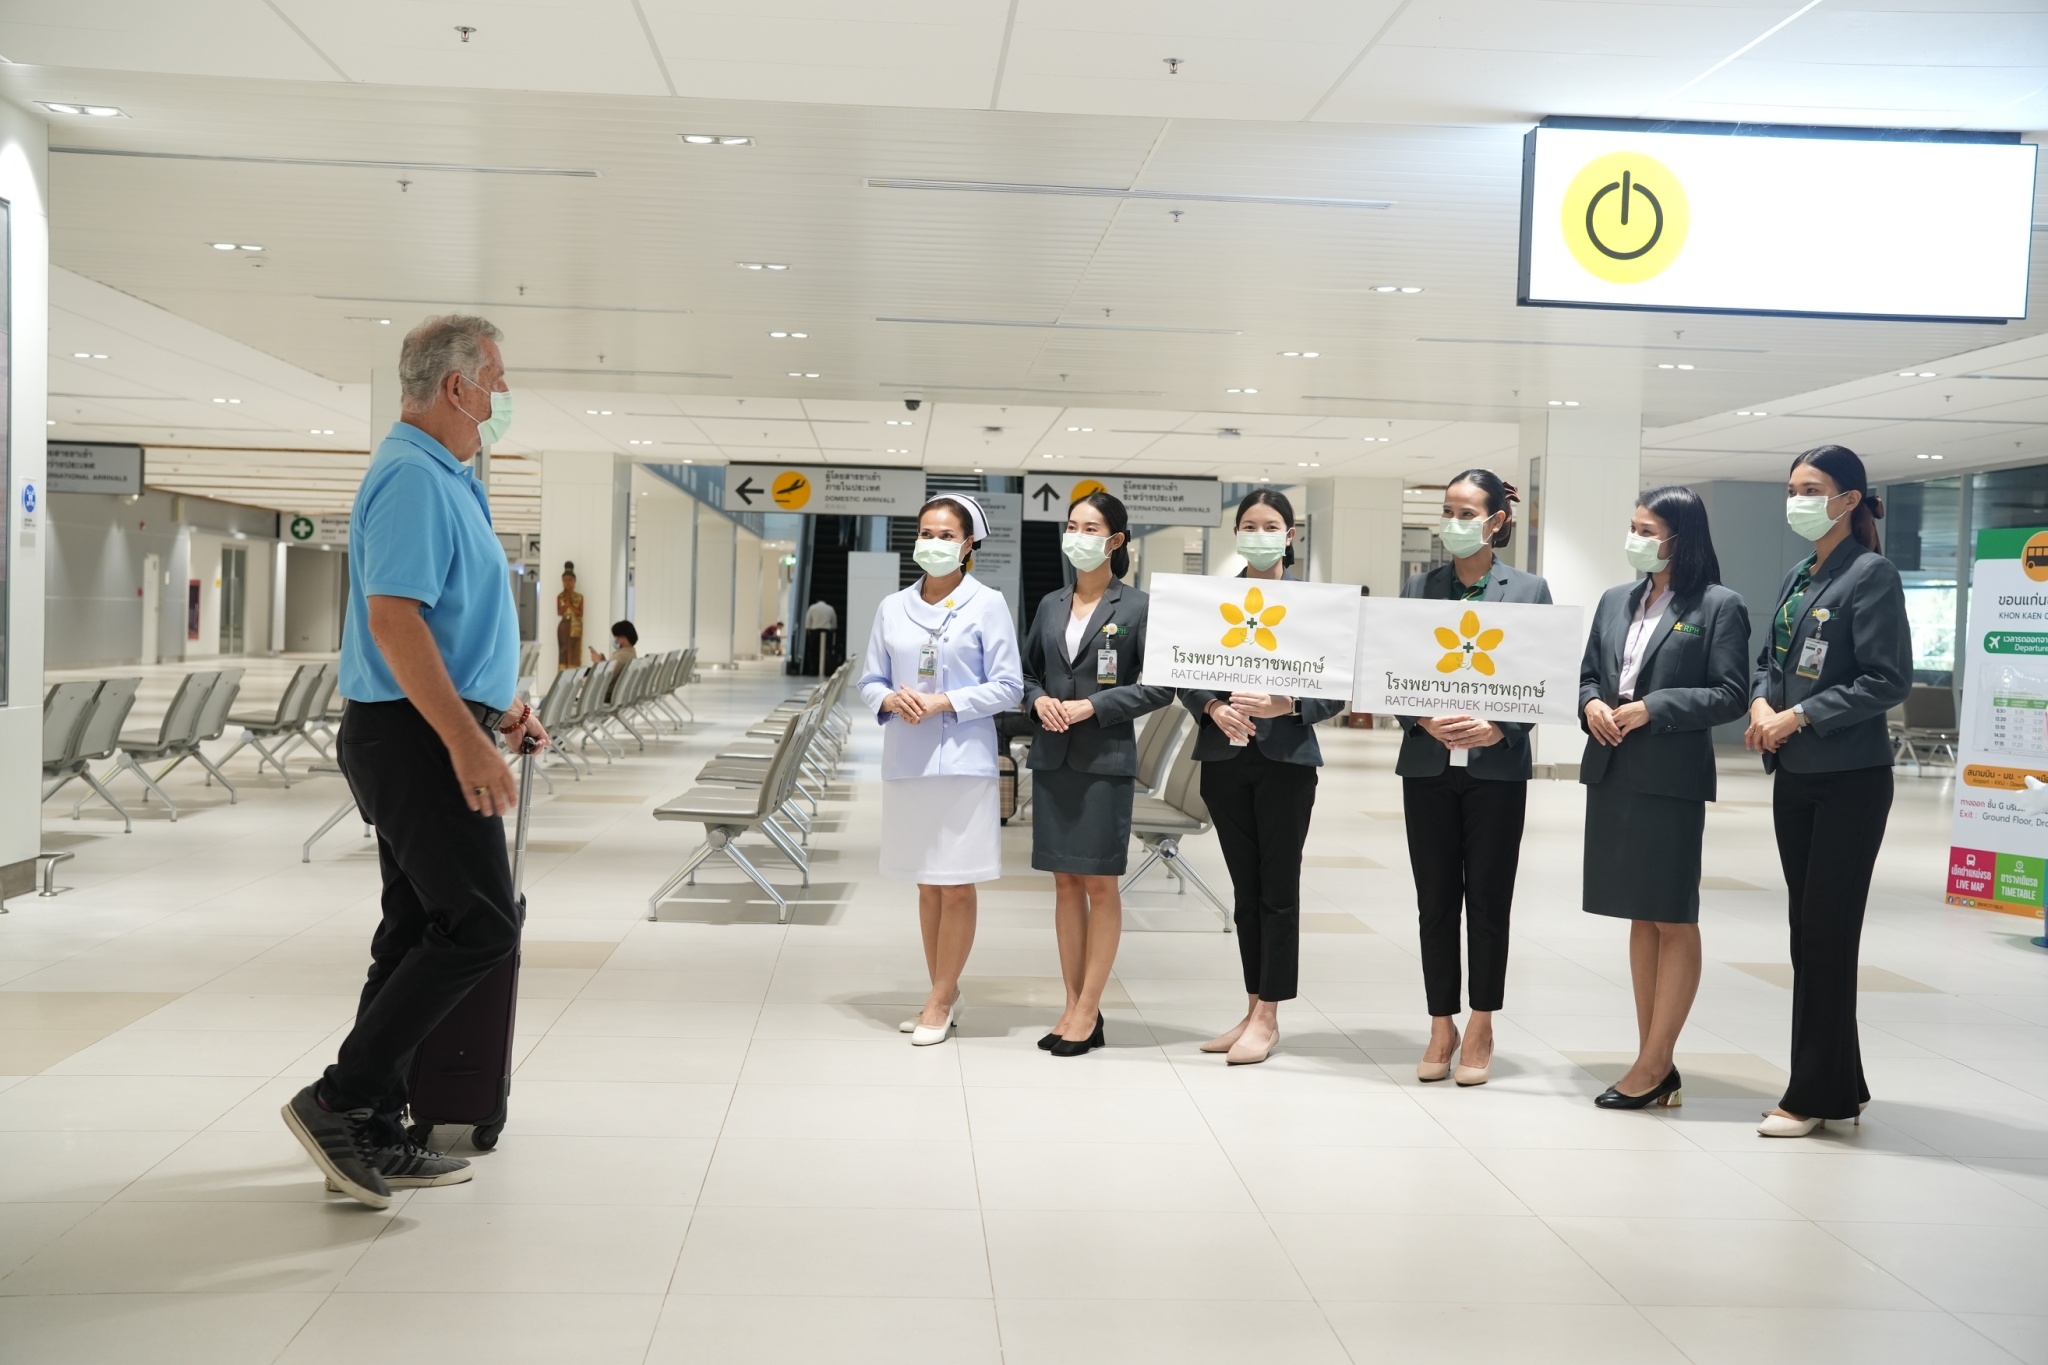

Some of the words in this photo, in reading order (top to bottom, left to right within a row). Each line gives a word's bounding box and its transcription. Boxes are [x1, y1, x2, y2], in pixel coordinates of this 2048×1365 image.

[1998, 592, 2048, 606] ขอนแก่น
[1998, 612, 2020, 620] KHON
[2022, 612, 2042, 620] KAEN
[1684, 624, 1700, 635] RPH
[1172, 646, 1326, 676] โรงพยาบาลราชพฤกษ์
[1171, 668, 1262, 685] RATCHAPHRUEK
[1266, 676, 1323, 690] HOSPITAL
[1385, 671, 1546, 700] โรงพยาบาลราชพฤกษ์
[1385, 695, 1480, 711] RATCHAPHRUEK
[1484, 701, 1544, 715] HOSPITAL
[1967, 769, 1995, 778] สนามบิน
[1960, 798, 1986, 808] ทางออก
[1988, 798, 1996, 809] ชั้น
[1998, 802, 2004, 810] G
[1960, 810, 1973, 818] Exit
[1982, 812, 2010, 823] Ground
[2012, 816, 2033, 827] Floor,
[1956, 879, 1970, 890] LIVE
[1970, 881, 1984, 892] MAP
[2000, 873, 2038, 888] ตารางเดินรถ
[2001, 886, 2036, 900] TIMETABLE
